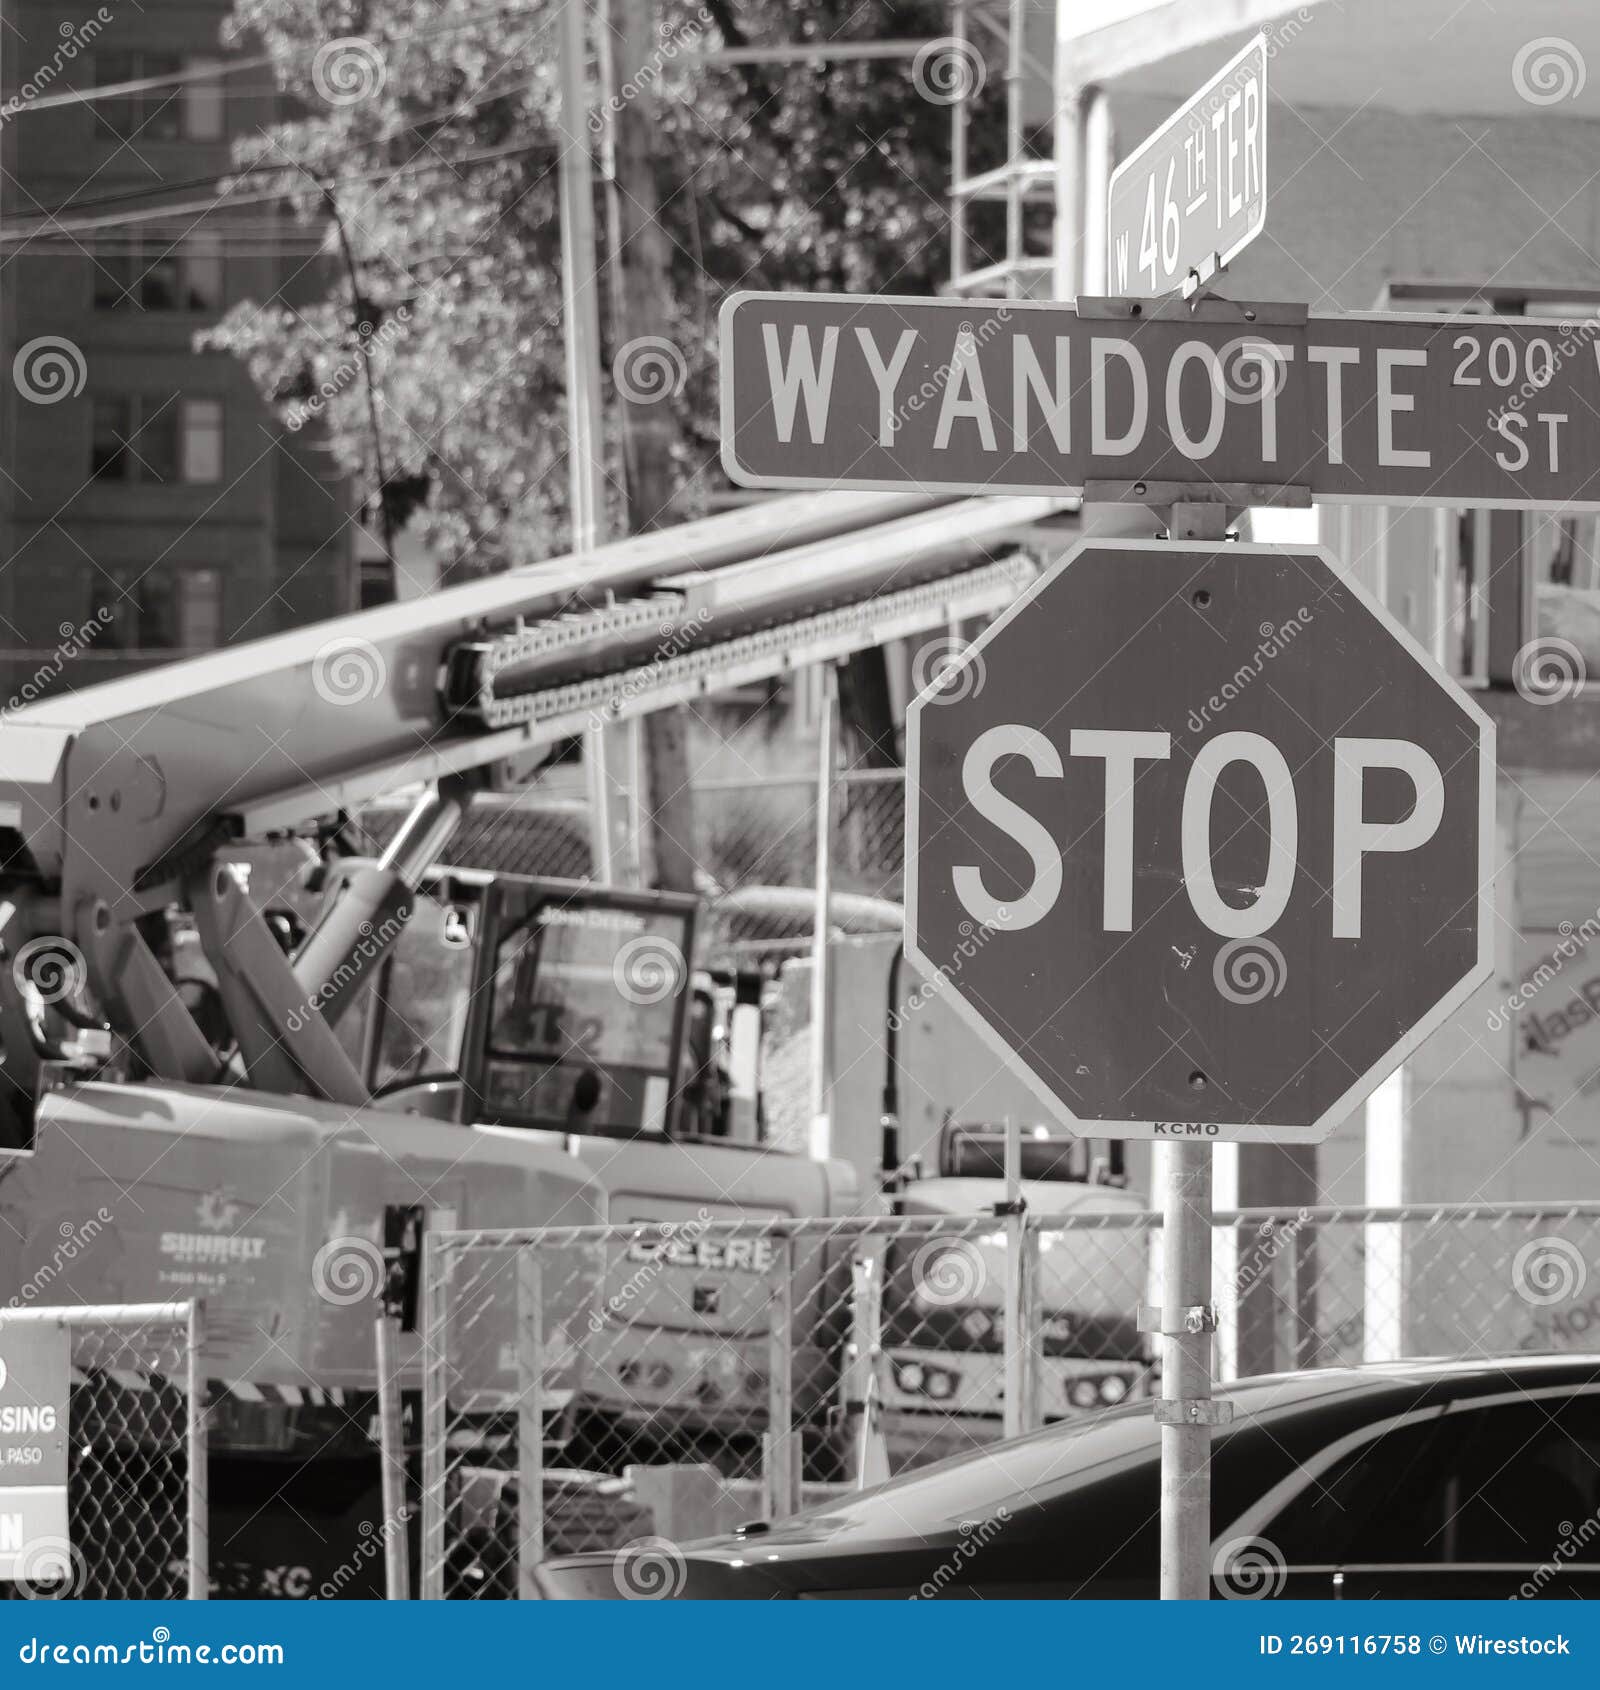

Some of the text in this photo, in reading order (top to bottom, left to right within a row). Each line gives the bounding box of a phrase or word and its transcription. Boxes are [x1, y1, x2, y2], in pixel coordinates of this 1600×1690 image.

[1116, 230, 1129, 295] W
[1212, 76, 1260, 230] TER
[762, 323, 1553, 468] WYANDOTTE 200
[1496, 412, 1568, 472] ST
[952, 724, 1445, 939] STOP
[1154, 1122, 1219, 1136] KCMO
[0, 1406, 56, 1433] SING
